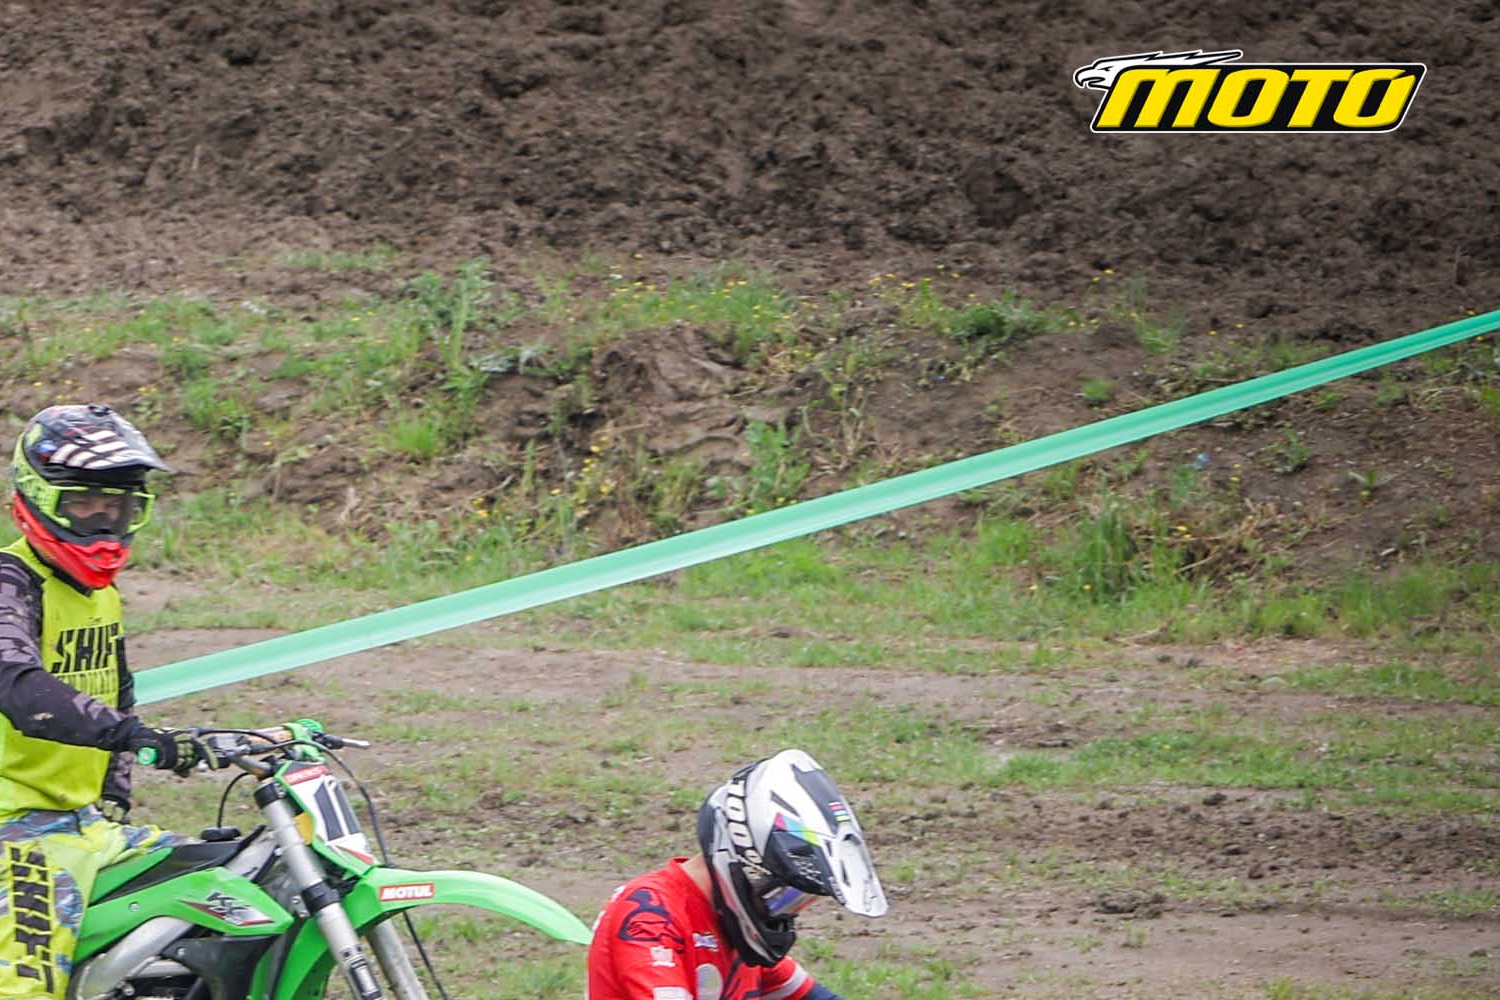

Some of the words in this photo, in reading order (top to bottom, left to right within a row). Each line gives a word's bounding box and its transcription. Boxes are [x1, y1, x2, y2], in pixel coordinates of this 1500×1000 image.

[725, 779, 773, 881] 100%
[11, 846, 55, 994] SHIFT
[381, 883, 434, 900] MOTUL
